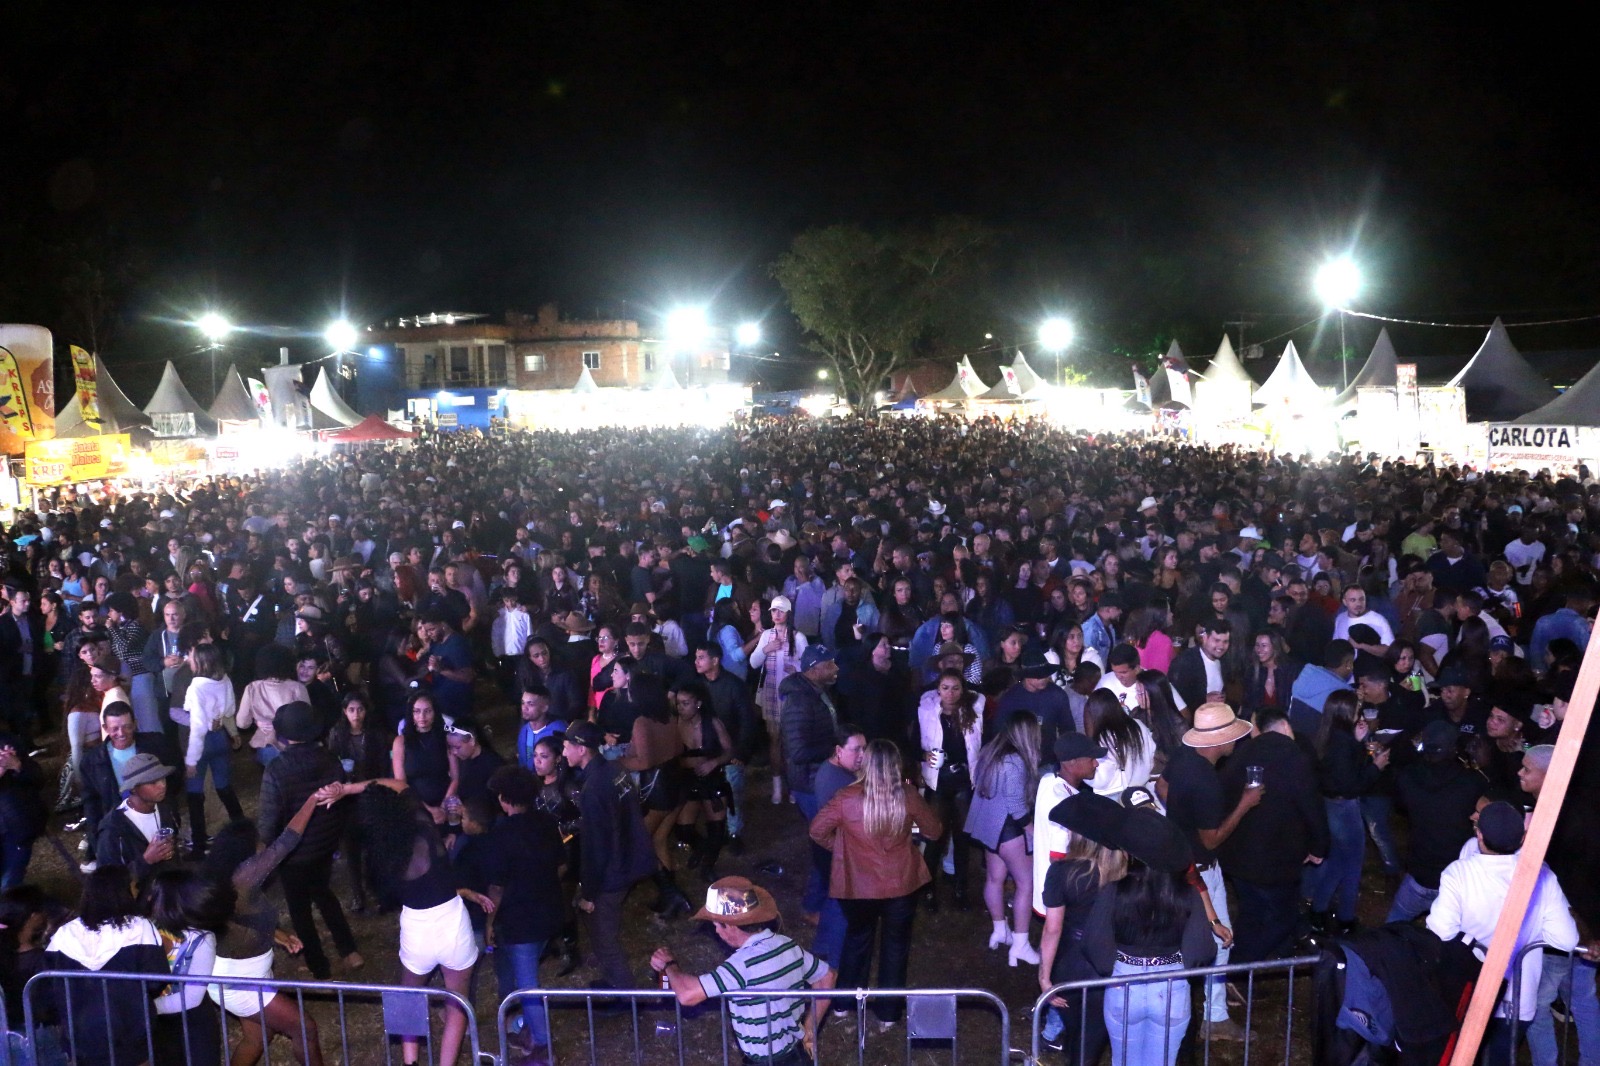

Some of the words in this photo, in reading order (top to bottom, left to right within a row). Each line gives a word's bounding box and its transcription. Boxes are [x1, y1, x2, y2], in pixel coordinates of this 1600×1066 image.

[8, 369, 30, 431] KREPS
[73, 441, 100, 453] Batata
[1489, 427, 1571, 448] CARLOTA
